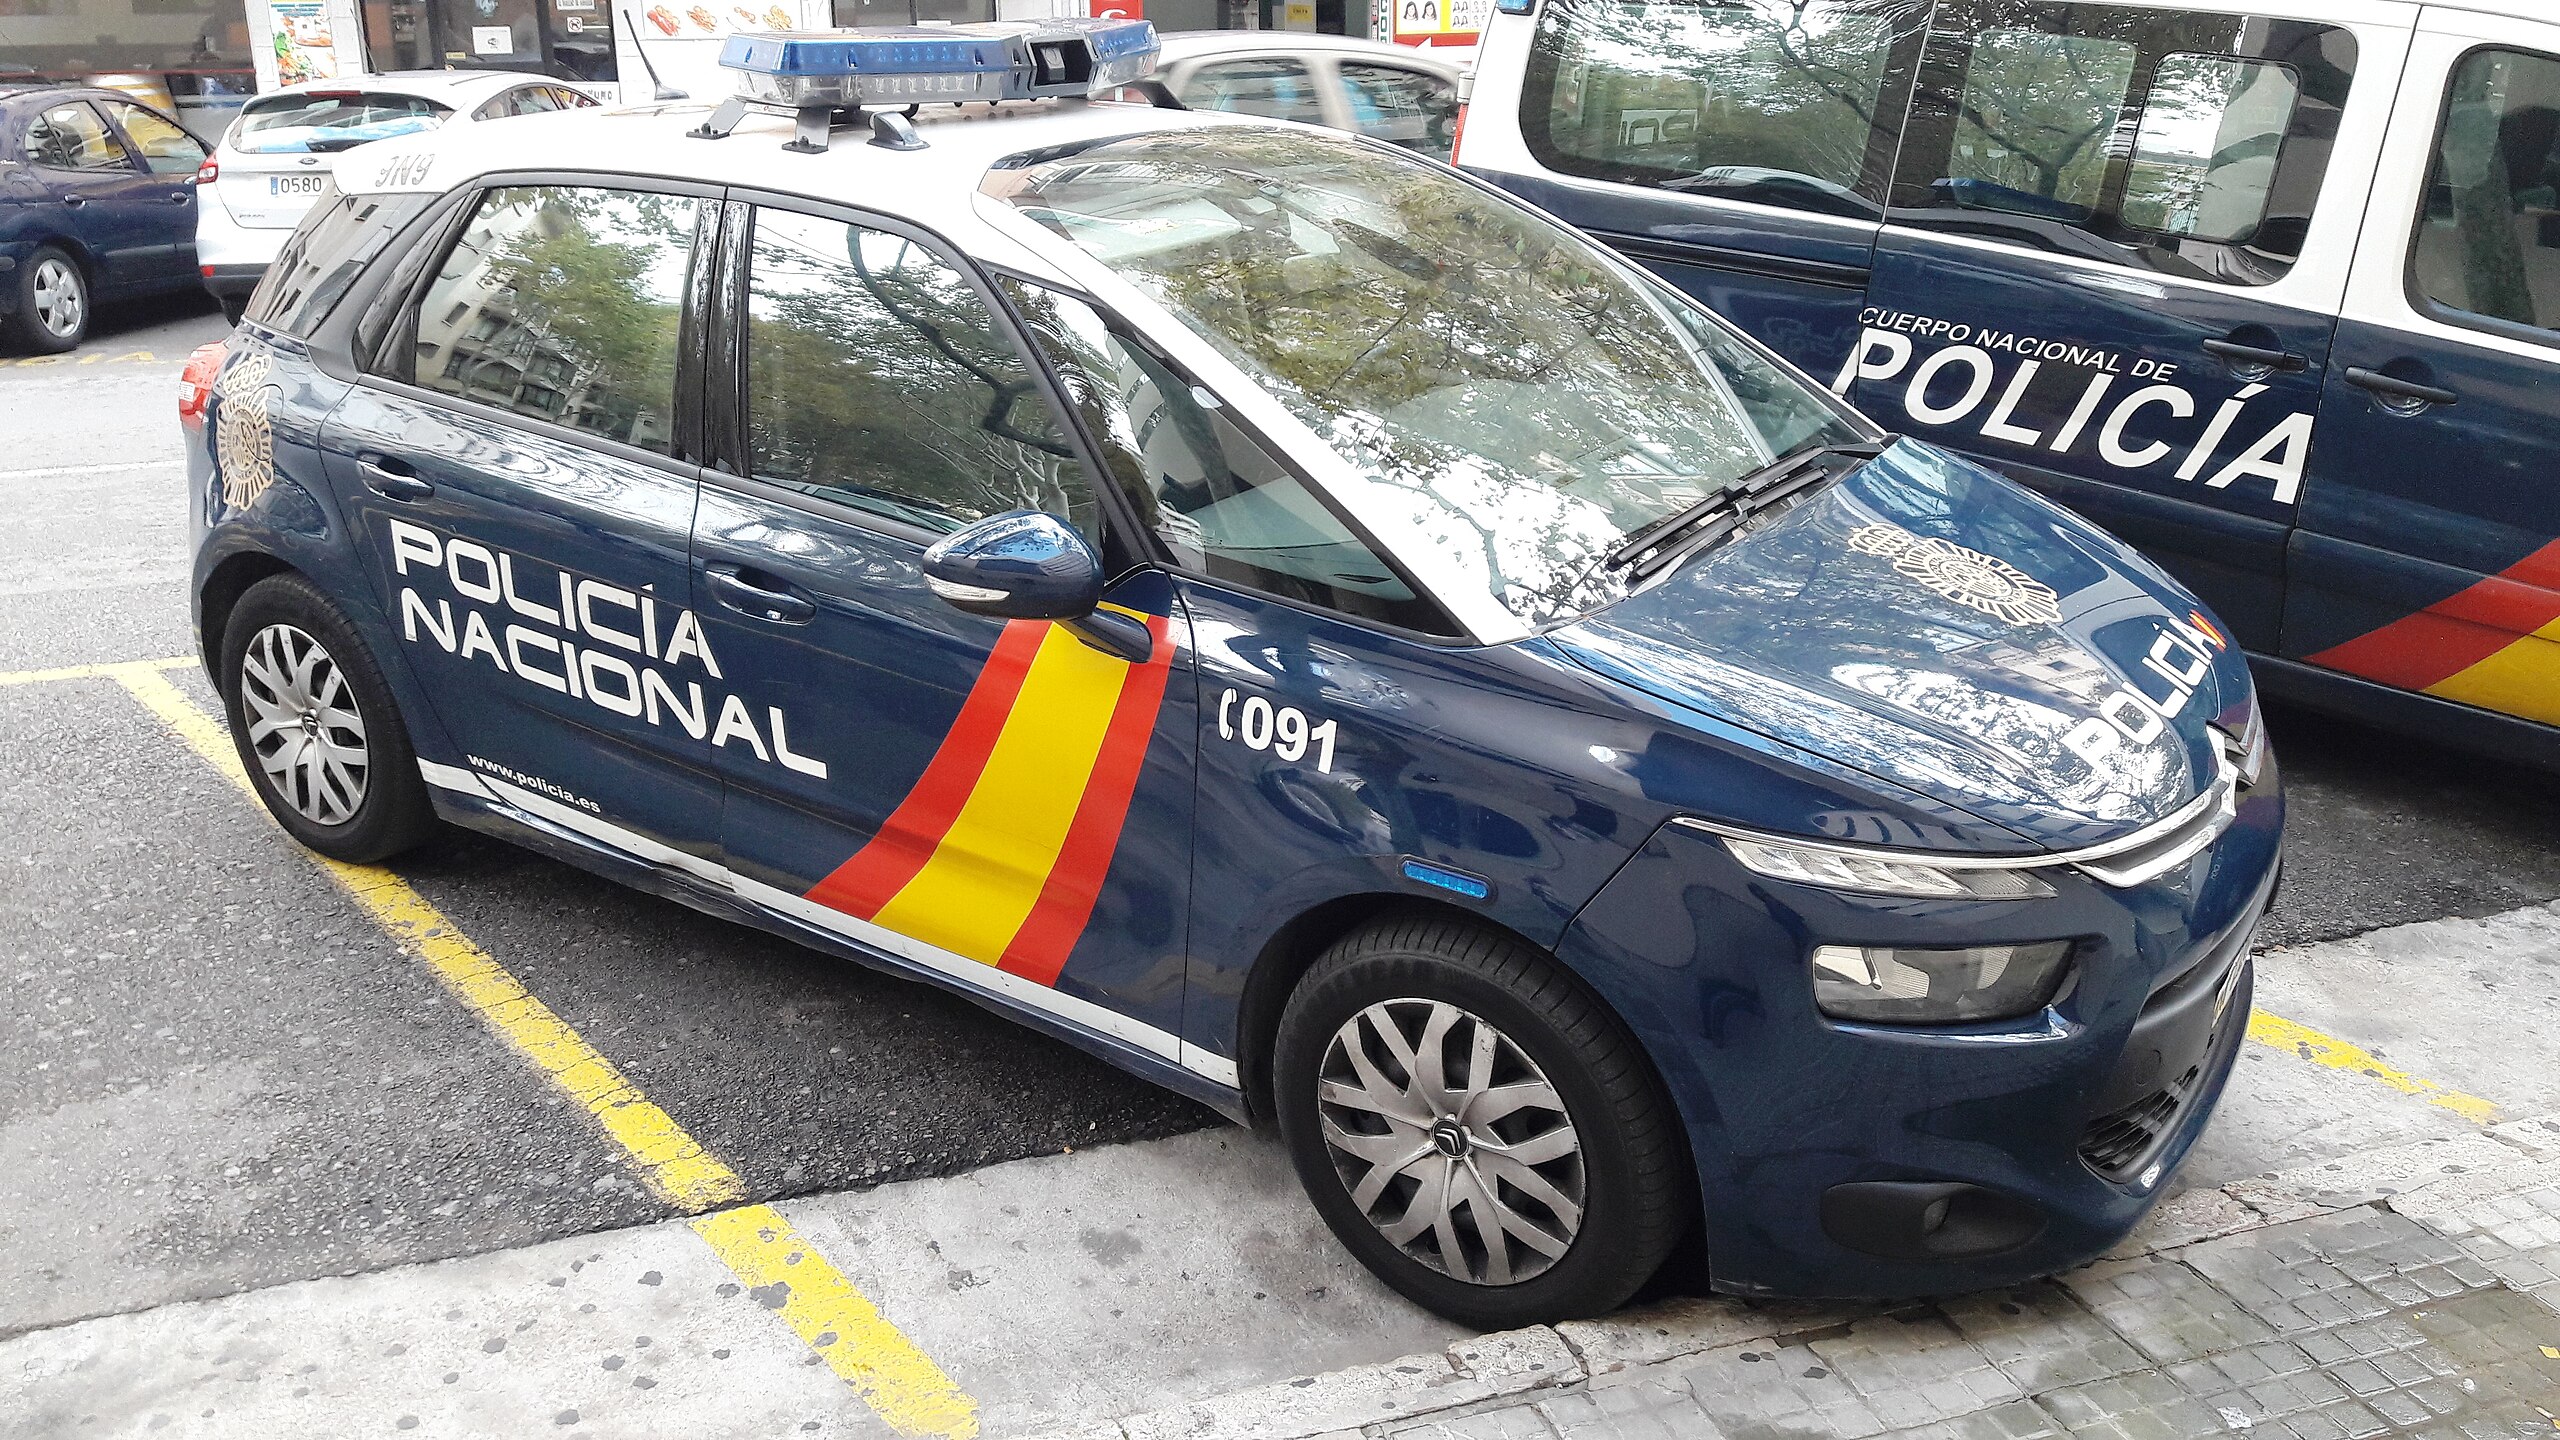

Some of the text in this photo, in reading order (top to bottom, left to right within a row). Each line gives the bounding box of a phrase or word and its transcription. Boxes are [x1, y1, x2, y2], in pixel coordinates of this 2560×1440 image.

[281, 177, 322, 193] 0580
[1858, 306, 2178, 383] CUERPO NACIONAL DE
[1830, 327, 2314, 505] POLICÍA
[390, 519, 722, 680] POLICÍA
[400, 587, 828, 779] NACIONAL
[1241, 695, 1338, 775] 091
[2059, 615, 2217, 776] POLICÍA
[466, 754, 602, 813] www.policia.es
